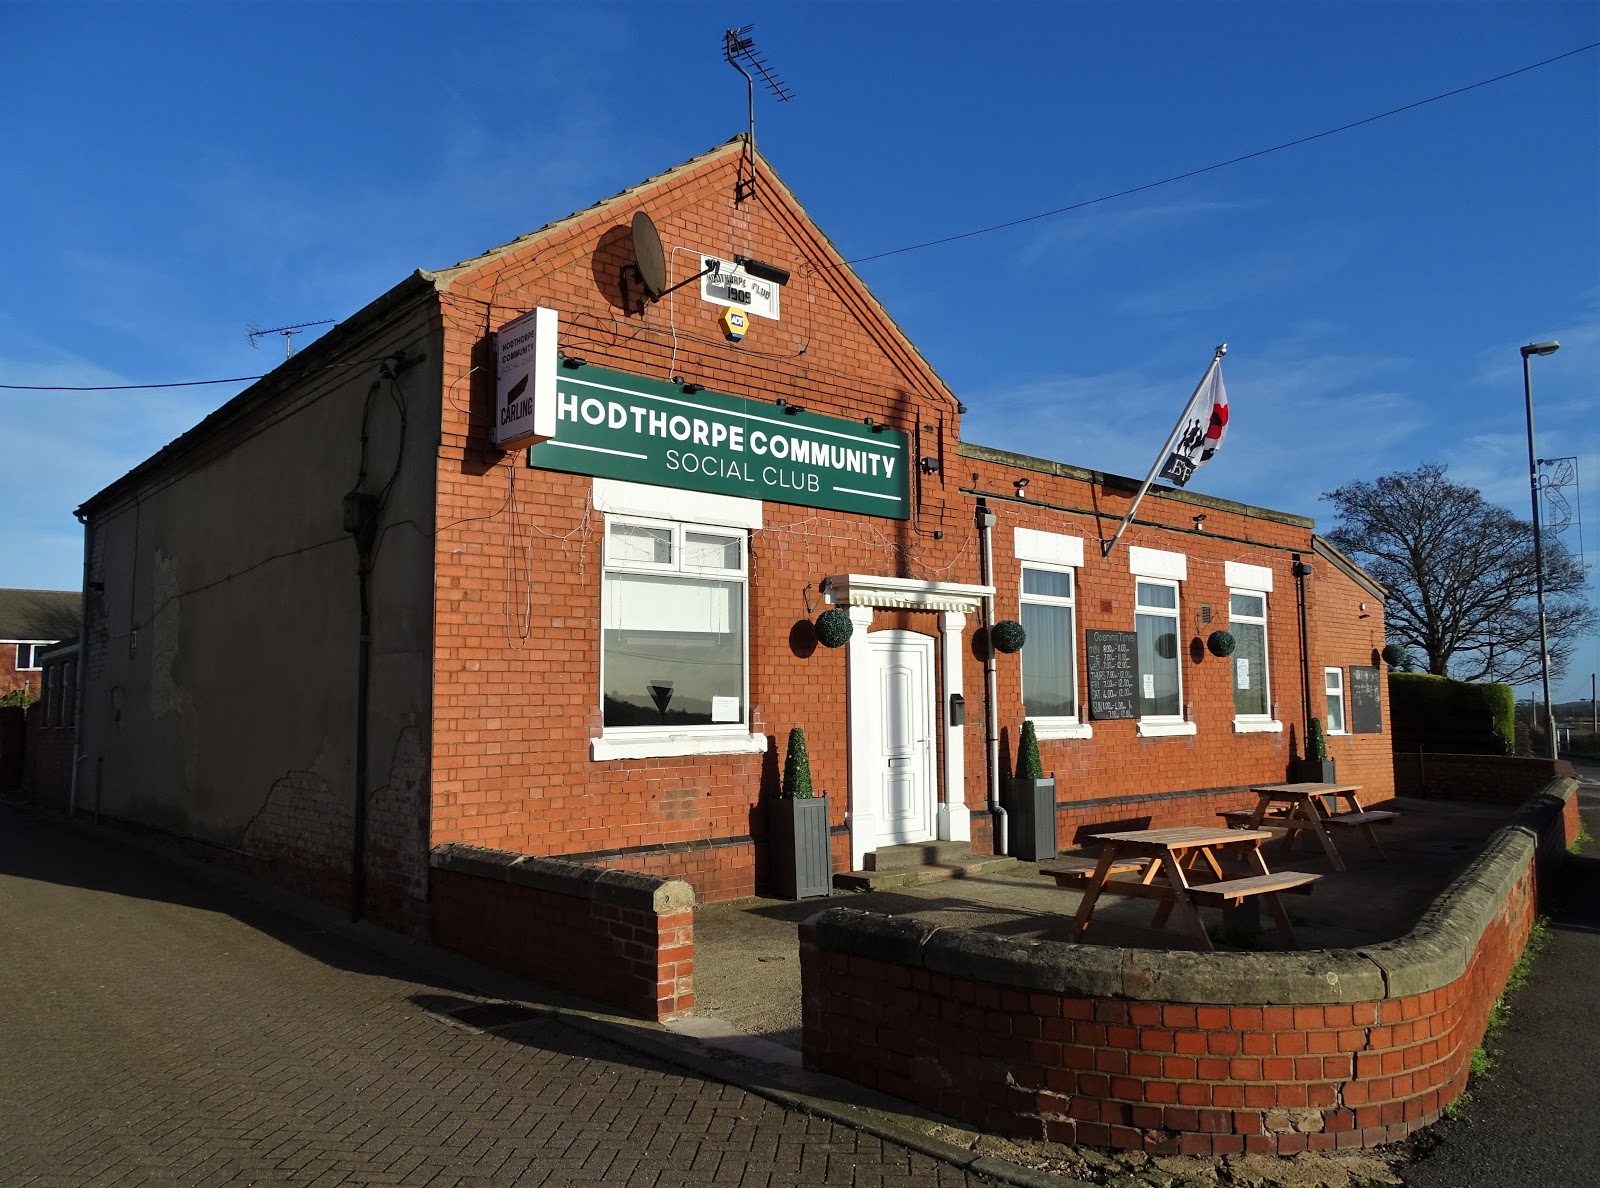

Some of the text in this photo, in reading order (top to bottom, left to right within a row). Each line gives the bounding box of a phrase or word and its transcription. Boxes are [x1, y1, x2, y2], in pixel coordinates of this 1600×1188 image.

[752, 283, 771, 300] CLUB
[731, 315, 744, 326] ADT
[502, 329, 535, 352] HODTHORPE
[502, 343, 534, 364] COMMUNITY
[501, 397, 533, 425] CARLING
[557, 392, 896, 479] HODTHORPE COMMUNITY
[666, 449, 820, 492] SOCIAL CLUB
[1093, 631, 1136, 646] Opening Times
[1090, 671, 1106, 680] THURS
[1091, 689, 1101, 699] SAT
[1092, 701, 1103, 713] SUN
